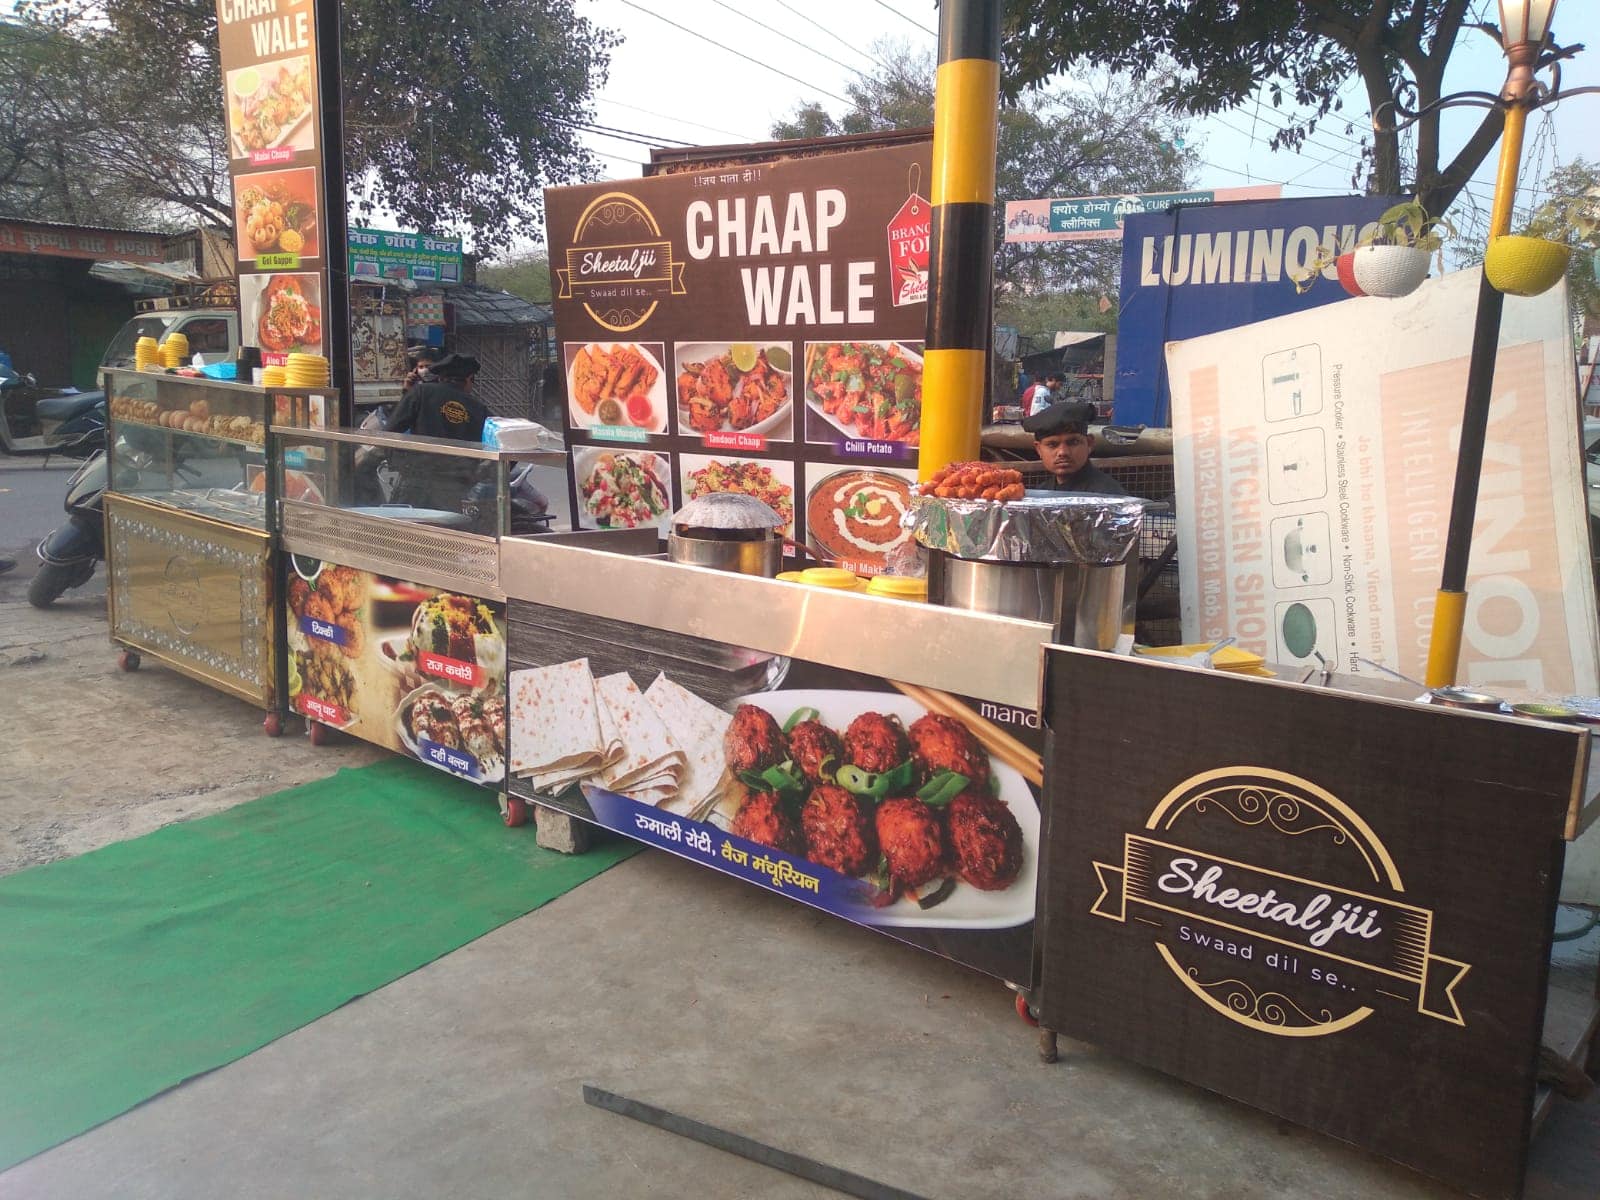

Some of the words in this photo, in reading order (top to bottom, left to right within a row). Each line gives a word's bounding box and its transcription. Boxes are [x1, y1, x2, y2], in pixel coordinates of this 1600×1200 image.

[251, 12, 309, 57] WALE
[686, 189, 847, 259] CHAAP
[1146, 200, 1170, 210] CURE
[590, 289, 617, 298] Swaad
[620, 288, 633, 297] dil
[740, 262, 875, 326] WALE
[1334, 401, 1345, 430] Cooker
[845, 441, 865, 452] Chilli
[867, 443, 892, 454] Potato
[1336, 441, 1347, 478] Stainless
[1228, 426, 1264, 564] KITCHEN
[1339, 501, 1351, 543] Cookware
[842, 561, 856, 572] Dal
[1343, 554, 1356, 594] Non-Stick
[1366, 569, 1381, 613] Vinod
[1345, 596, 1357, 638] Cookware
[1349, 651, 1360, 672] Hard
[635, 813, 682, 842] रुमाली
[1179, 926, 1253, 960] Swaad
[1266, 951, 1298, 974] dil
